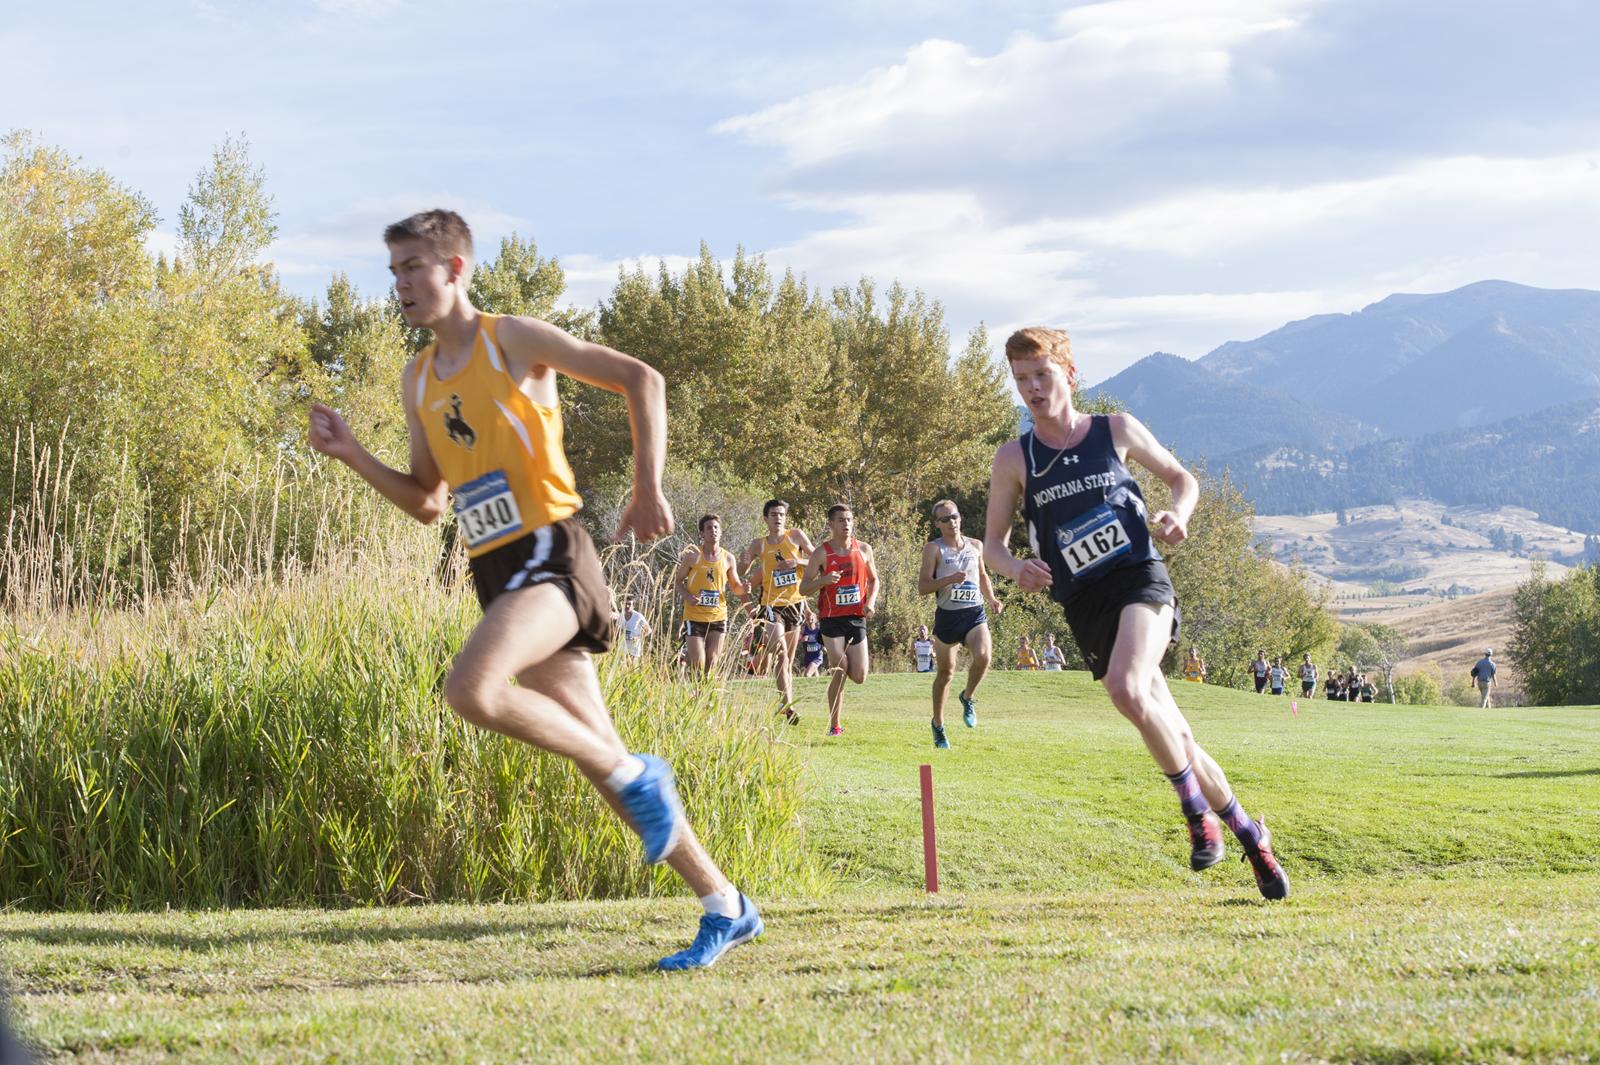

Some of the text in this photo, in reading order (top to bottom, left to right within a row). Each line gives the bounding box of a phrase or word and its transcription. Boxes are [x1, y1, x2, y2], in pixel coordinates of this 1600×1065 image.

[1033, 471, 1117, 507] MONTANA STATE
[461, 497, 513, 539] 1340
[1068, 524, 1125, 569] 1162
[776, 574, 796, 585] 1344
[837, 593, 859, 604] 1121
[953, 589, 977, 601] 1292
